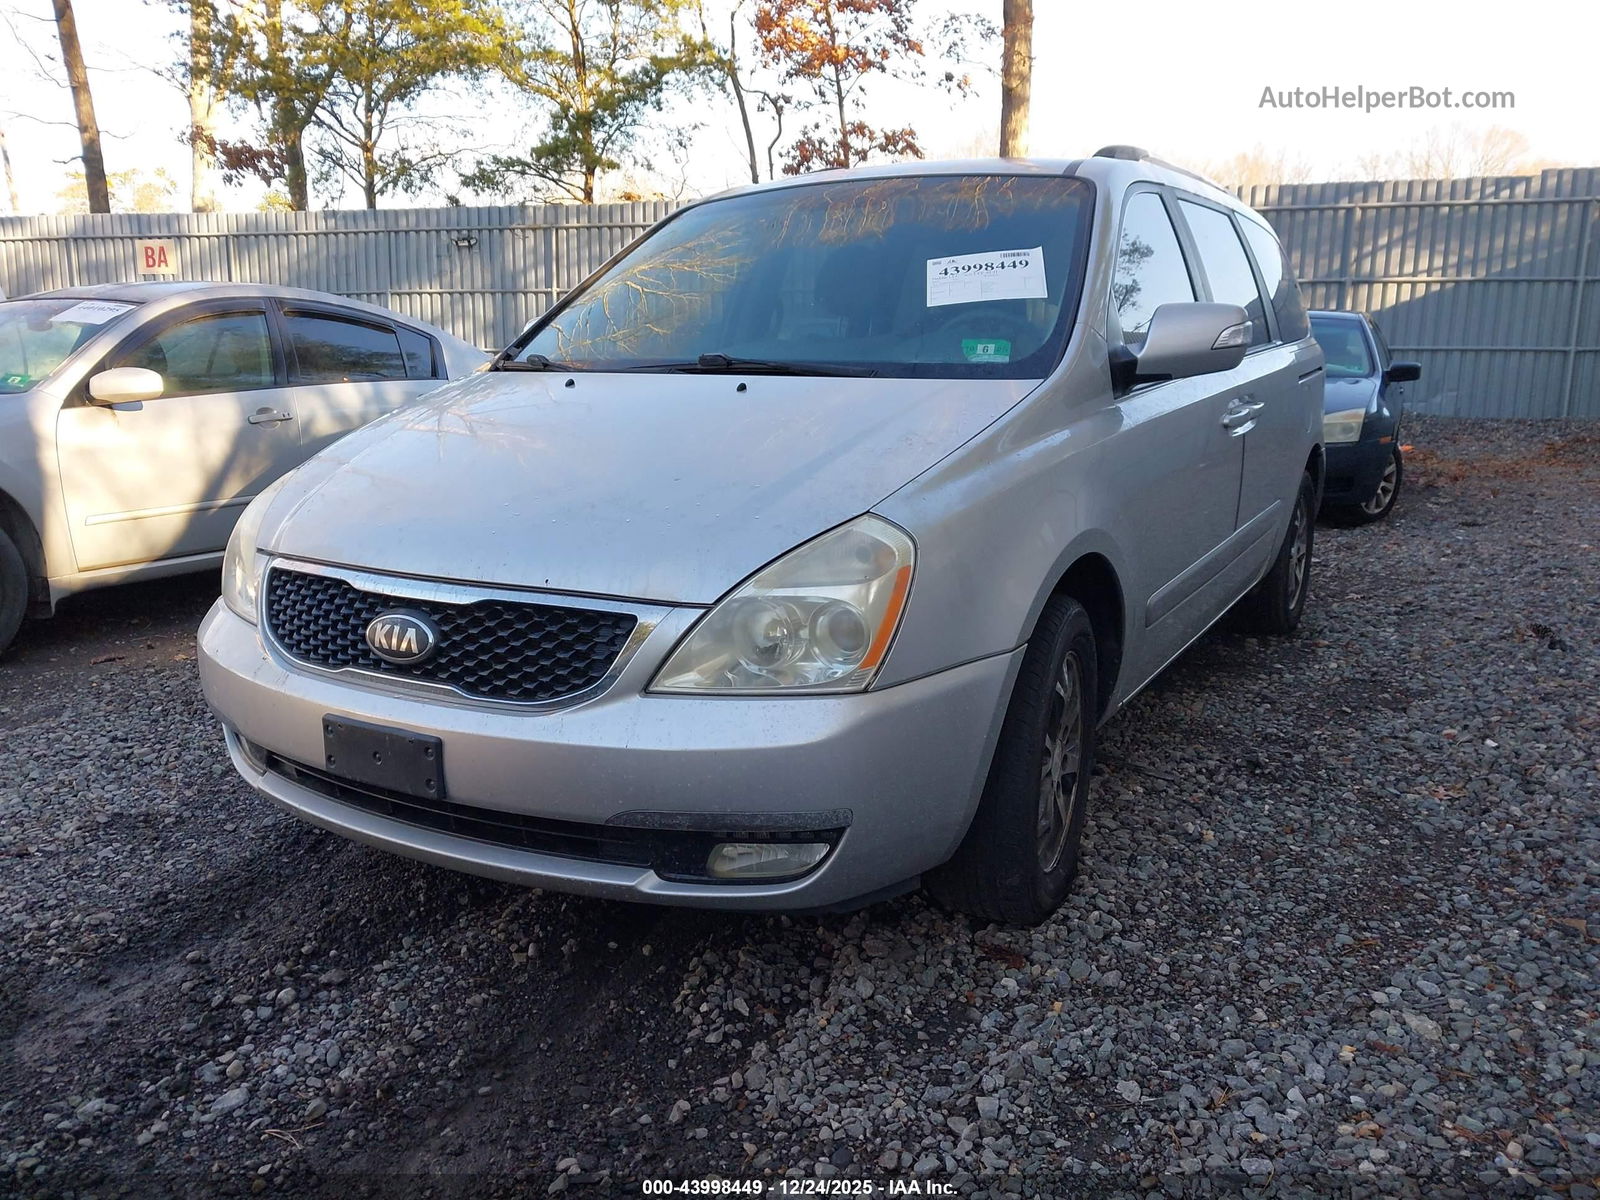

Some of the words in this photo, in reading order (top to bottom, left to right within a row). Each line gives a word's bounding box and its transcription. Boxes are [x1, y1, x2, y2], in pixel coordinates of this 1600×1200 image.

[143, 245, 169, 268] BA
[938, 259, 1030, 276] 43998449
[374, 621, 419, 655] KIA
